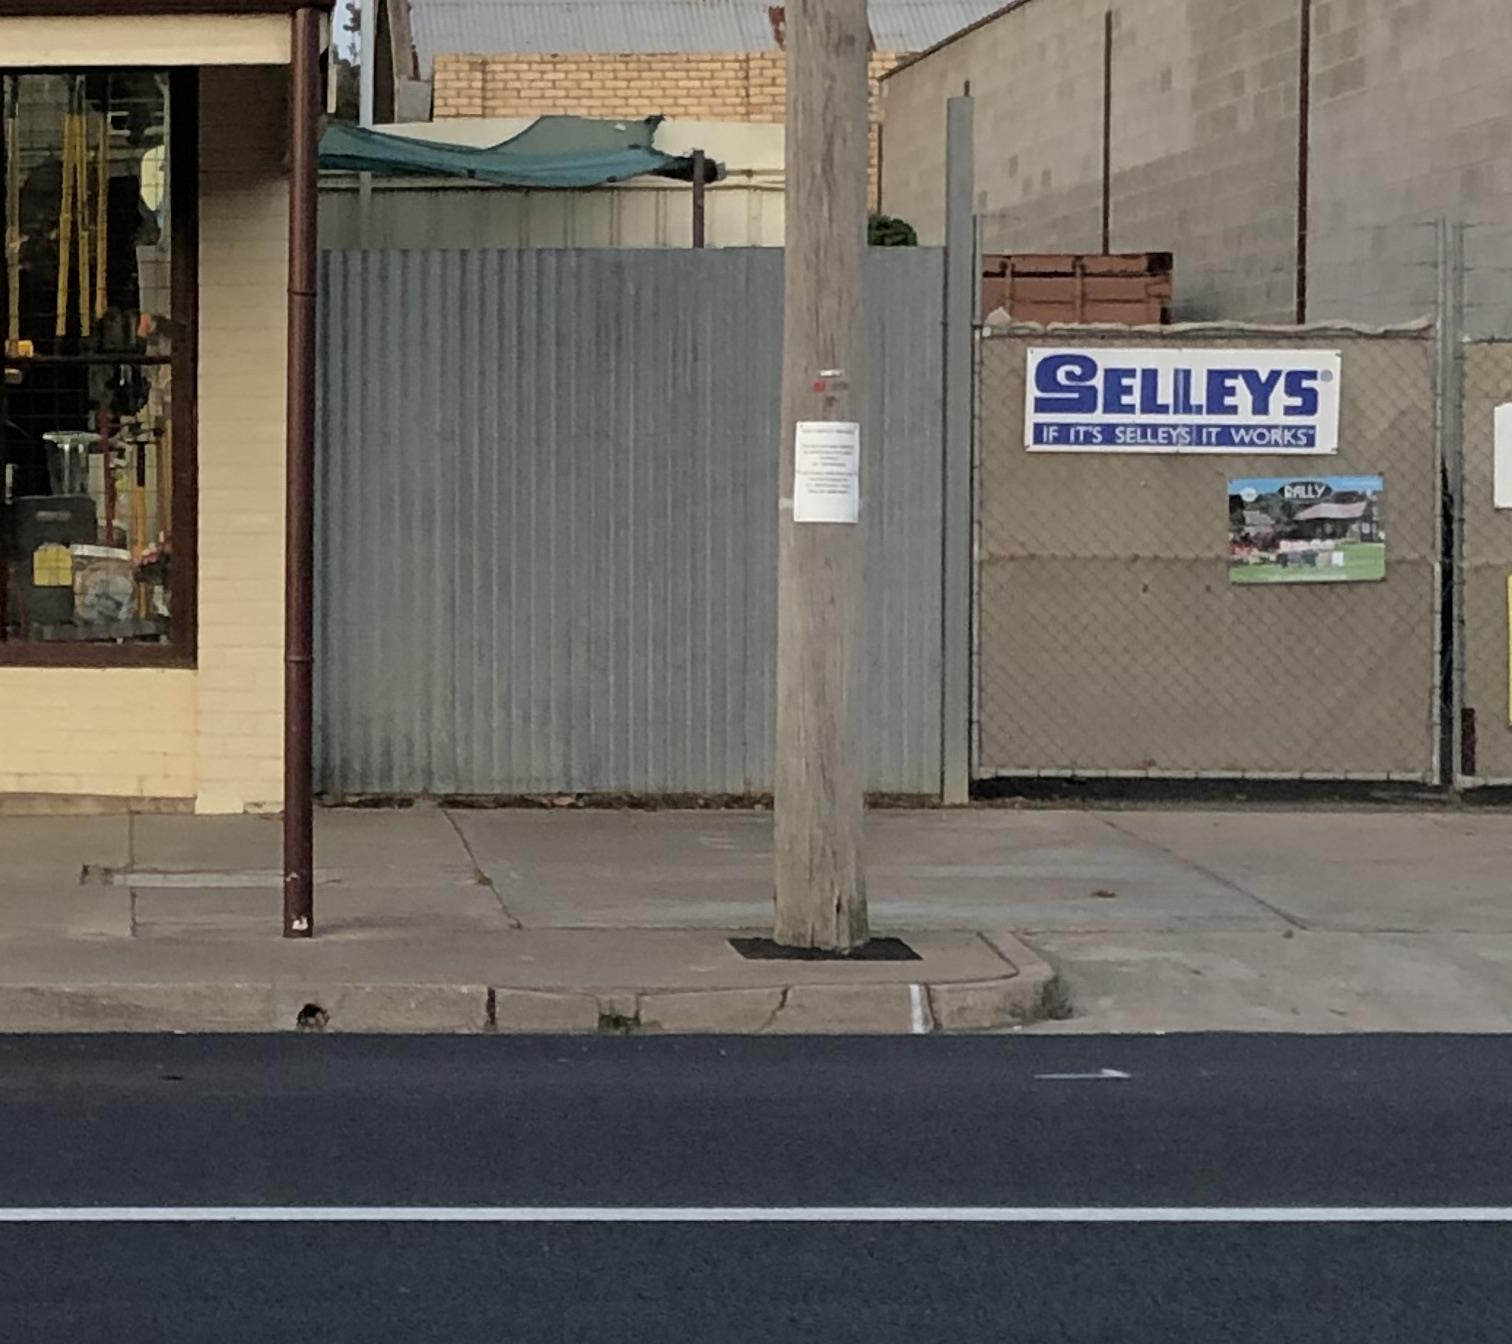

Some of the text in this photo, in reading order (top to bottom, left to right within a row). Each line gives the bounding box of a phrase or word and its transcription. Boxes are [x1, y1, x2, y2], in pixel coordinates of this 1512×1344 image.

[1034, 353, 1319, 416] SELLEYS
[1042, 426, 1059, 443] IF
[1069, 426, 1103, 443] IT'S
[1114, 426, 1190, 444] SELLEYS
[1201, 427, 1222, 445] IT
